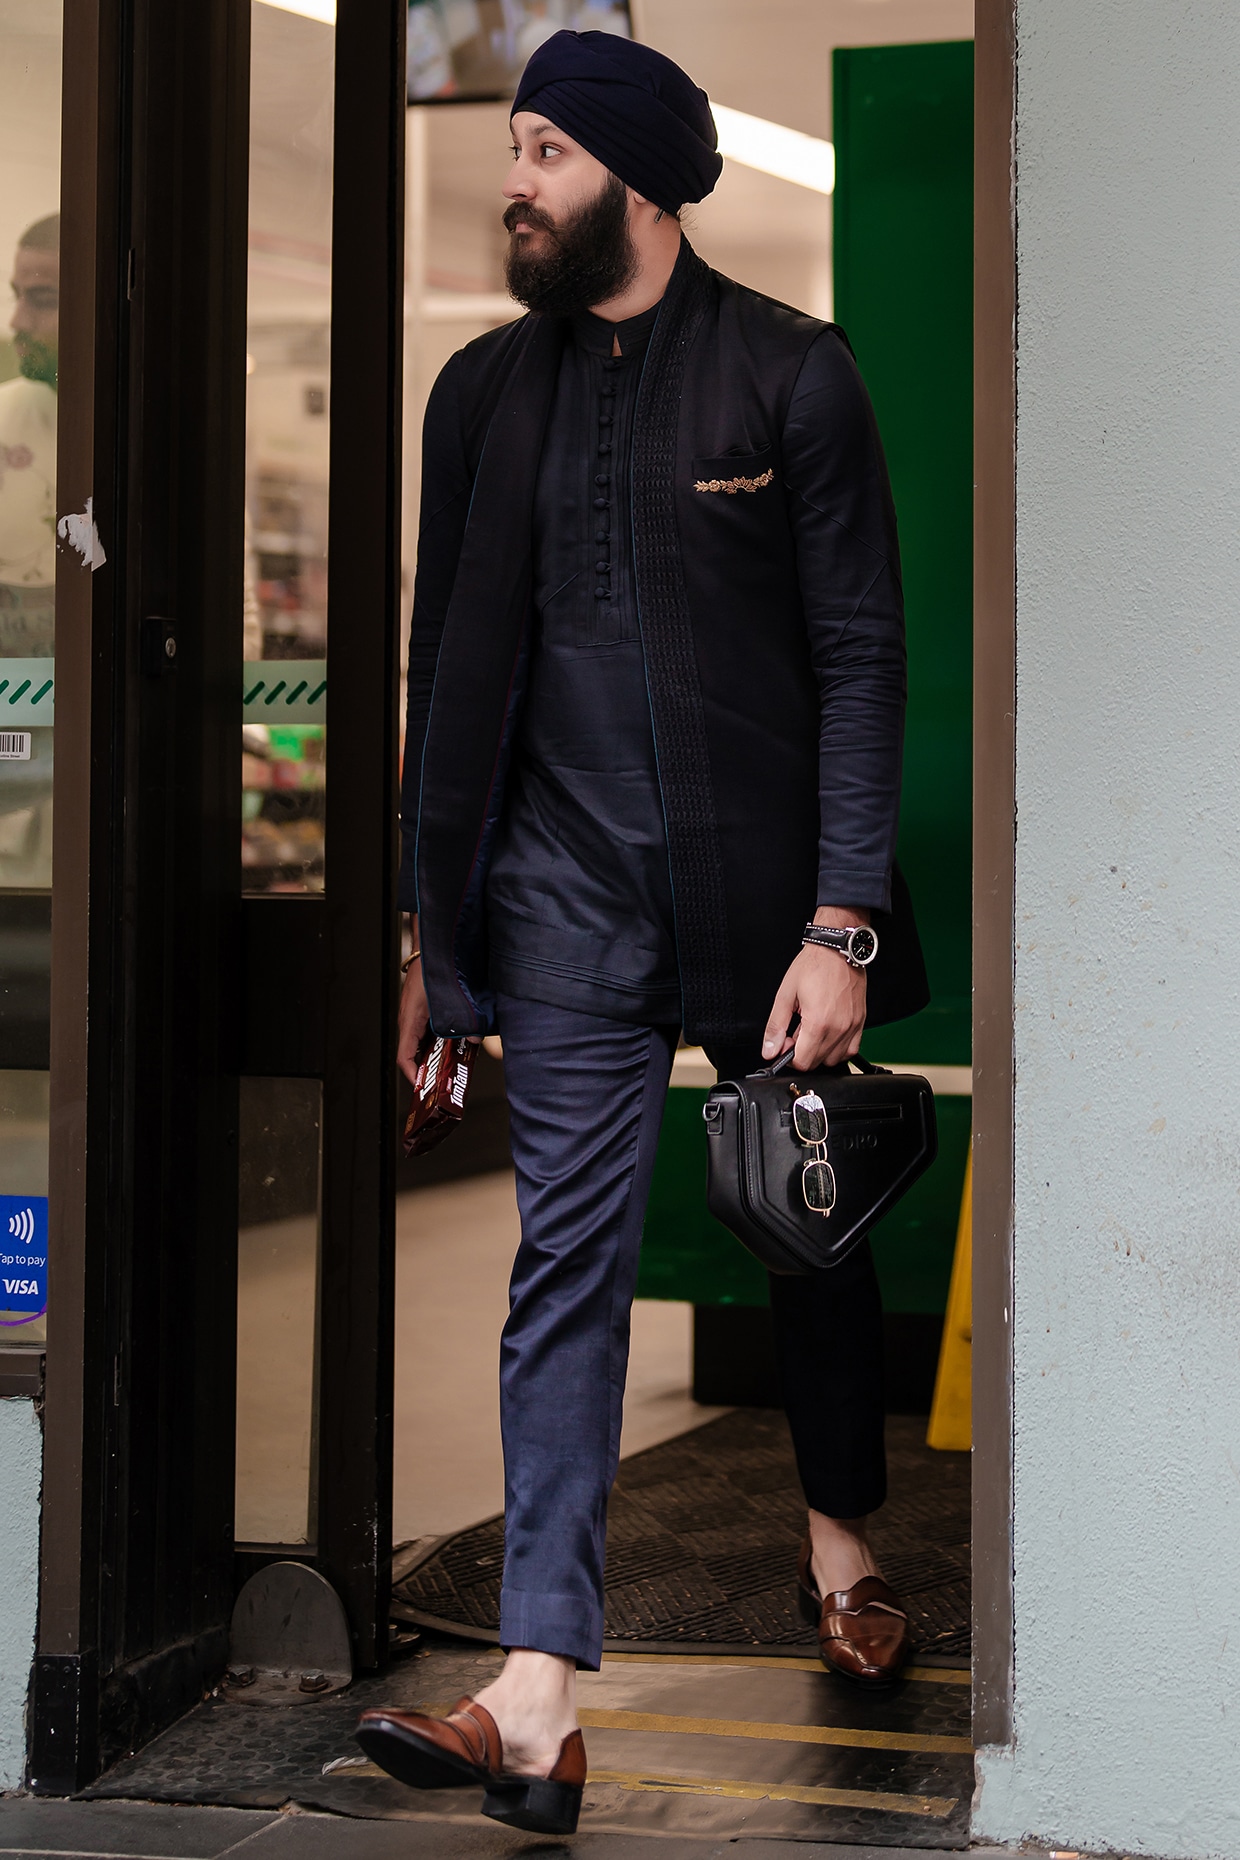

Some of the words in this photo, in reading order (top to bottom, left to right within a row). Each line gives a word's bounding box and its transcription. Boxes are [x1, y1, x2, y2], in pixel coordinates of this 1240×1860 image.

[420, 1036, 445, 1101] TimTa
[831, 1133, 878, 1151] EDRO
[15, 1255, 26, 1265] to
[27, 1256, 46, 1267] pay
[2, 1279, 39, 1295] VISA
